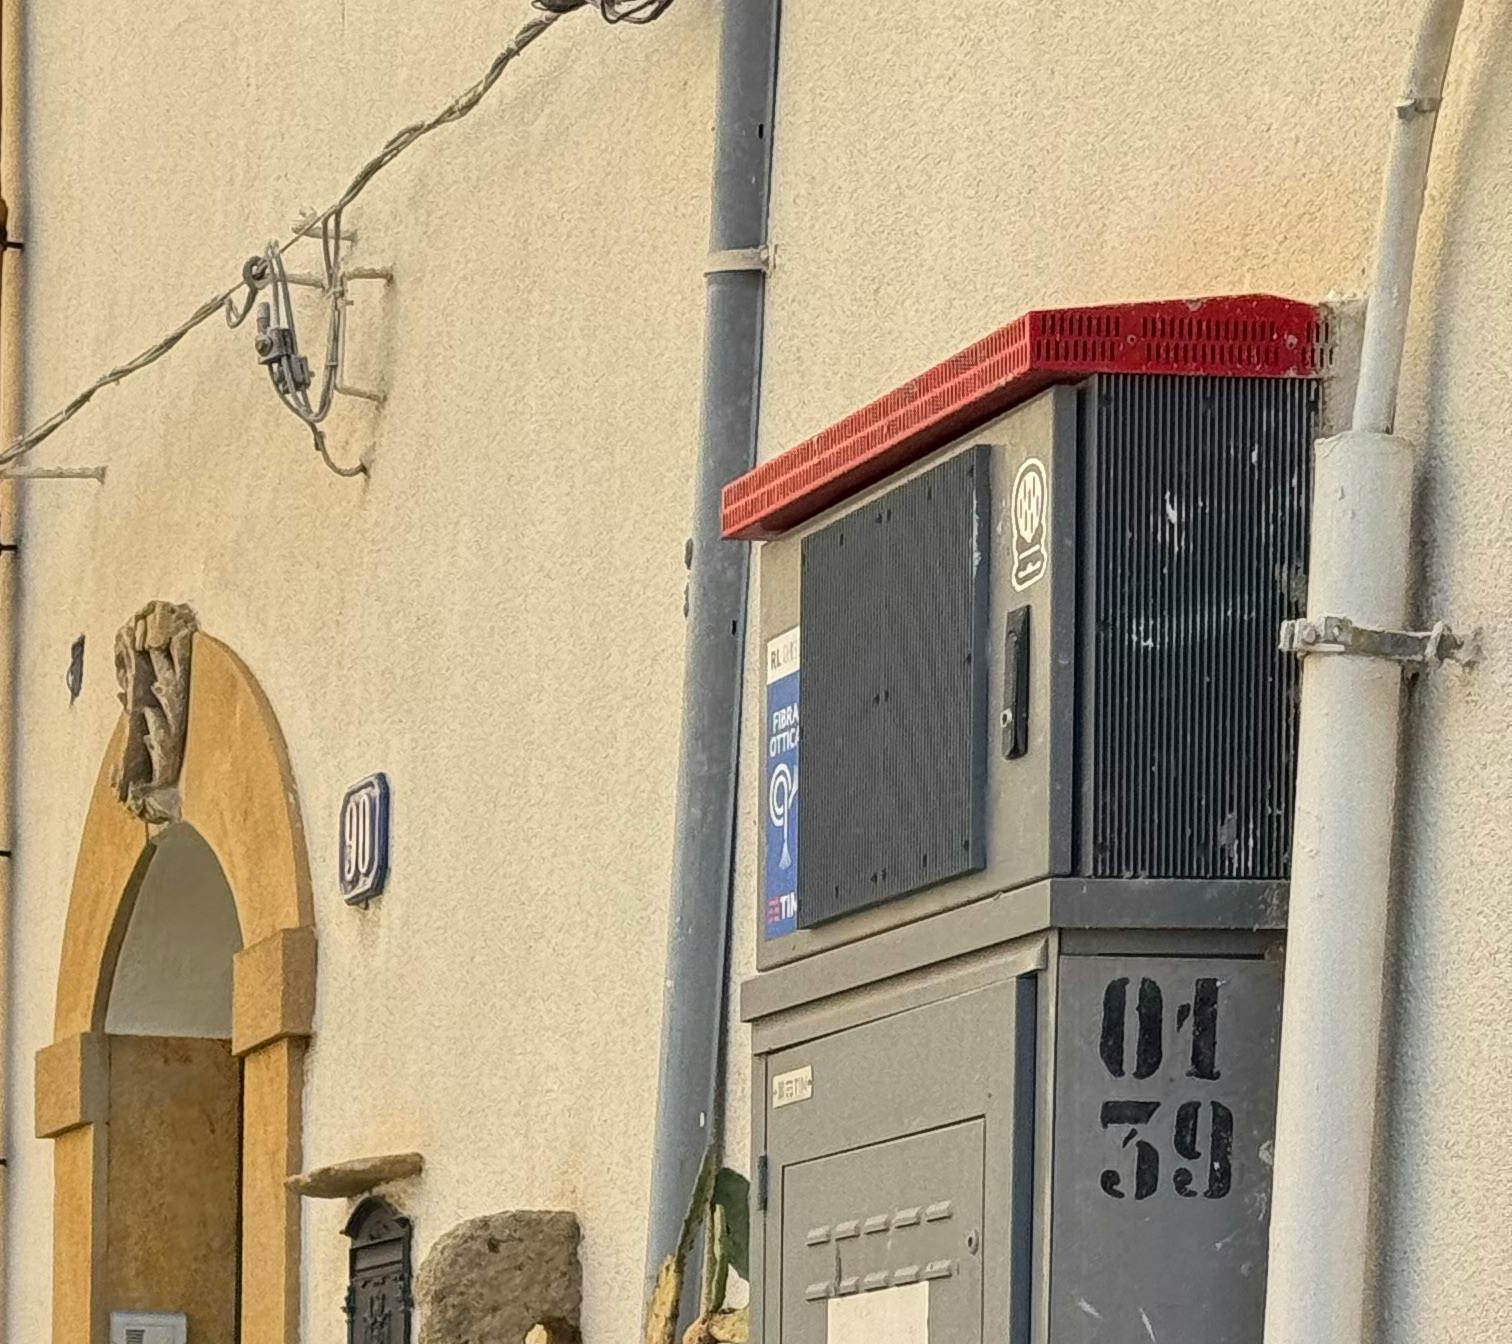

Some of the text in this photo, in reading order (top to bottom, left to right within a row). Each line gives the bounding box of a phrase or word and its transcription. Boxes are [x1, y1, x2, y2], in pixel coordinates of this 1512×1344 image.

[345, 793, 369, 882] 90
[1100, 977, 1220, 1079] 01
[1101, 1101, 1234, 1199] 39
